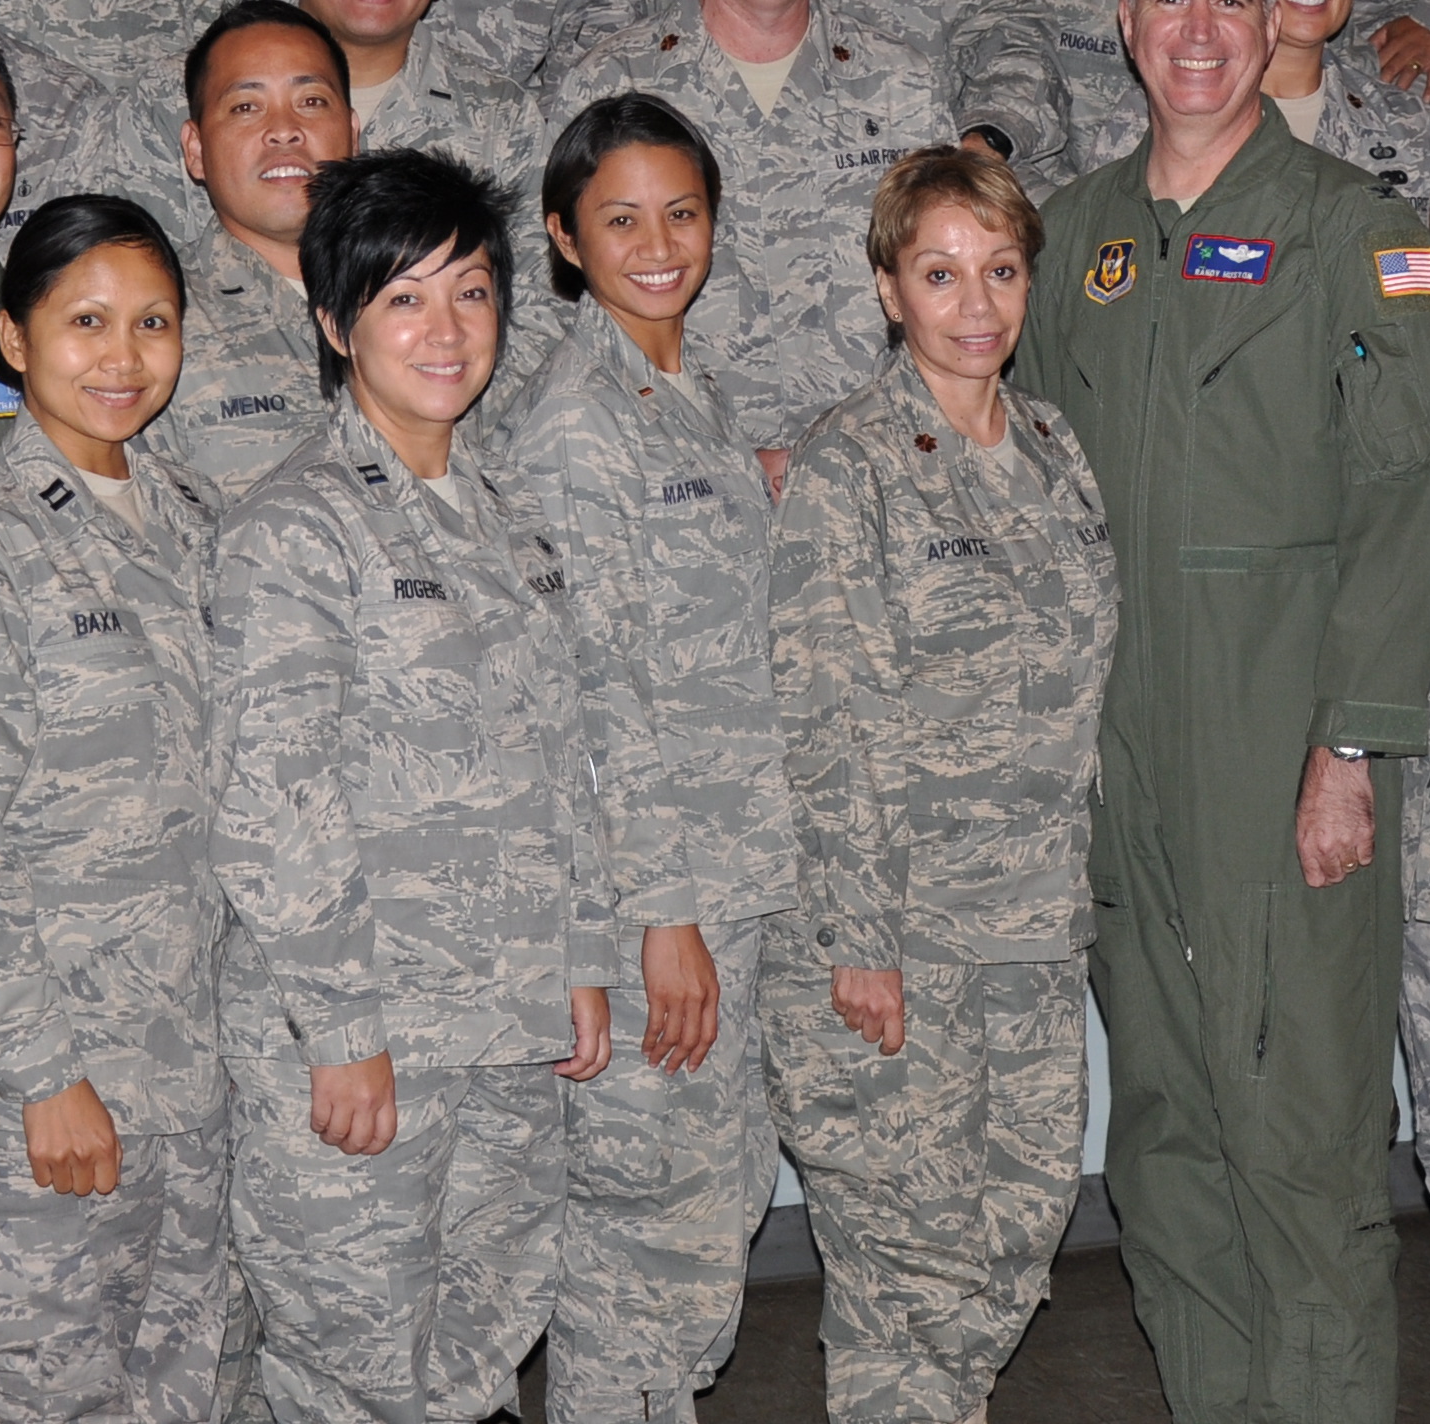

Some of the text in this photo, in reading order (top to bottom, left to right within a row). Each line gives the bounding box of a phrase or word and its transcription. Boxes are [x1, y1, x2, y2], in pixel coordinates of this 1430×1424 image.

[1059, 32, 1118, 56] RUGGLES
[834, 153, 859, 170] U.S.
[860, 149, 882, 168] AIR
[1194, 268, 1221, 277] RANDY
[219, 393, 287, 420] MENO
[662, 477, 714, 506] MAFNAS
[927, 537, 991, 562] APONTE
[393, 577, 447, 601] ROGERS
[74, 611, 123, 637] BAXA
